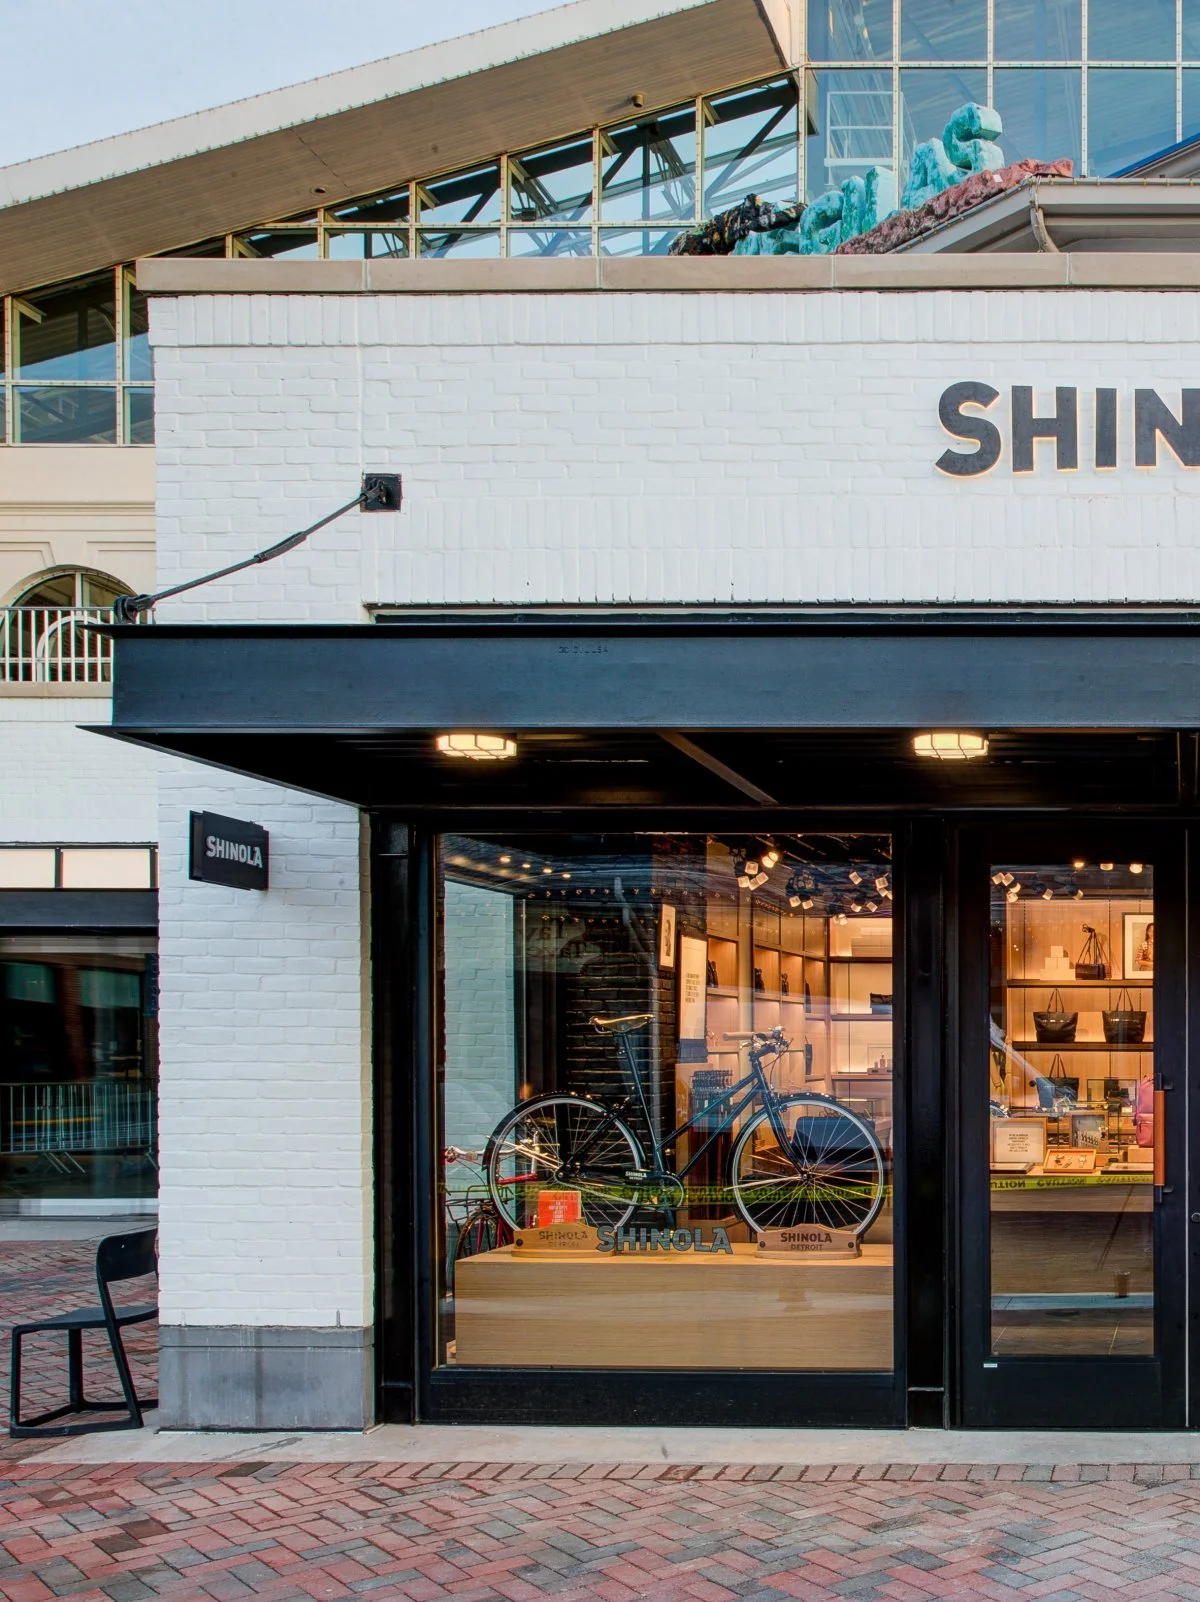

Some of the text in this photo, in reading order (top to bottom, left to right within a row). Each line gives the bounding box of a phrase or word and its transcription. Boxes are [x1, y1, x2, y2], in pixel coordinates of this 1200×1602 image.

[205, 835, 263, 868] SHINOLA
[539, 1231, 589, 1241] SHINOLA
[595, 1225, 733, 1255] SHINOLA
[780, 1232, 832, 1243] SHINOLA
[790, 1243, 823, 1251] DETROIT
